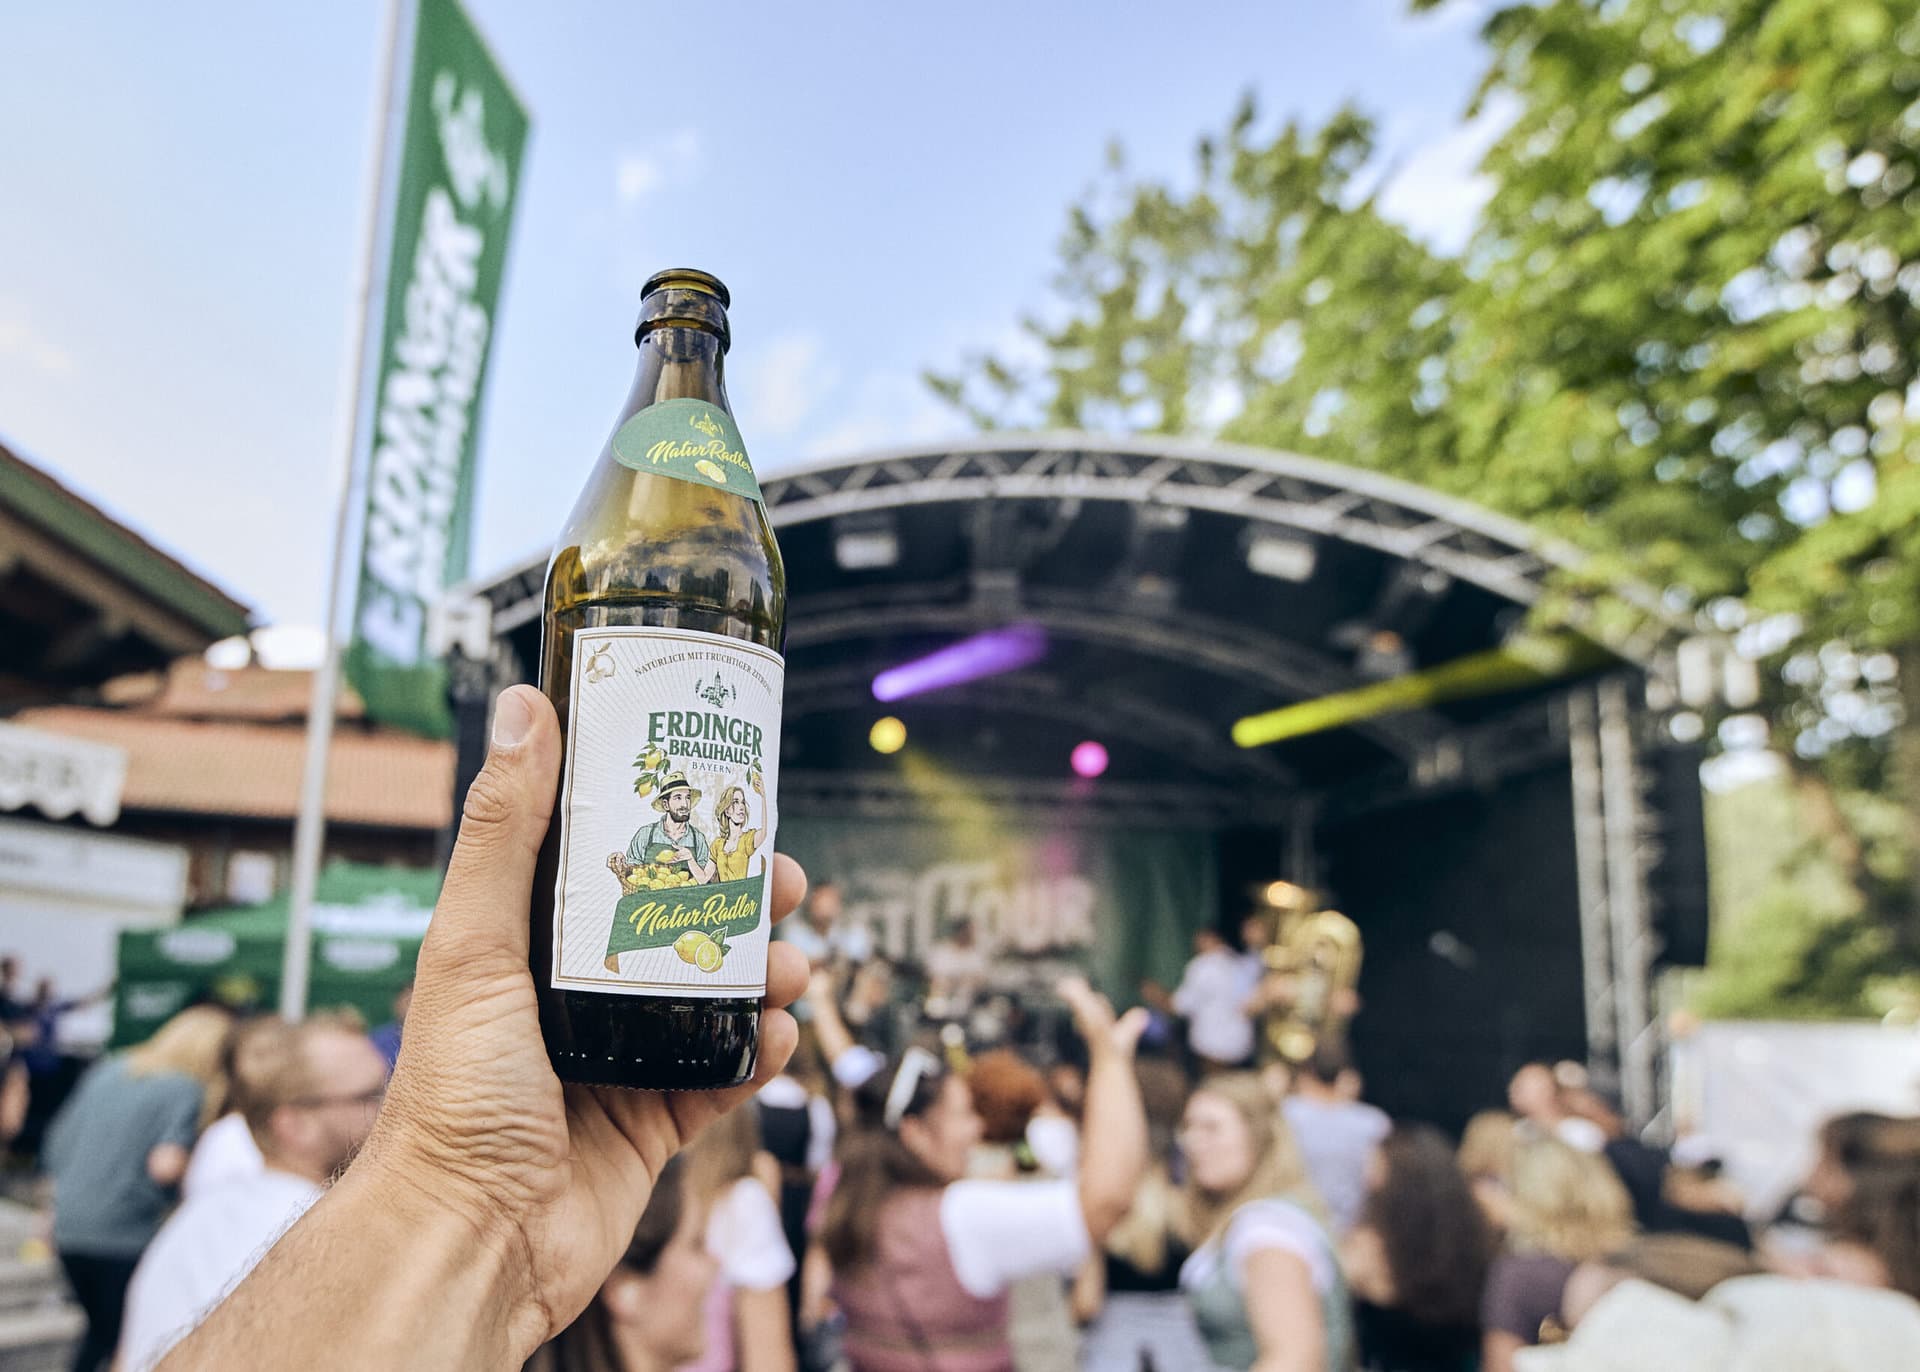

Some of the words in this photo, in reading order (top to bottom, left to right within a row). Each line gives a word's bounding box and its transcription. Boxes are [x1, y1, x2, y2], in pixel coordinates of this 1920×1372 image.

[646, 439, 753, 474] NaturRadler
[687, 651, 703, 661] MIT
[648, 711, 763, 757] ERDINGER
[668, 739, 750, 766] BRAUHAUS
[692, 761, 732, 774] BAYERN
[629, 893, 758, 936] NaturRadler
